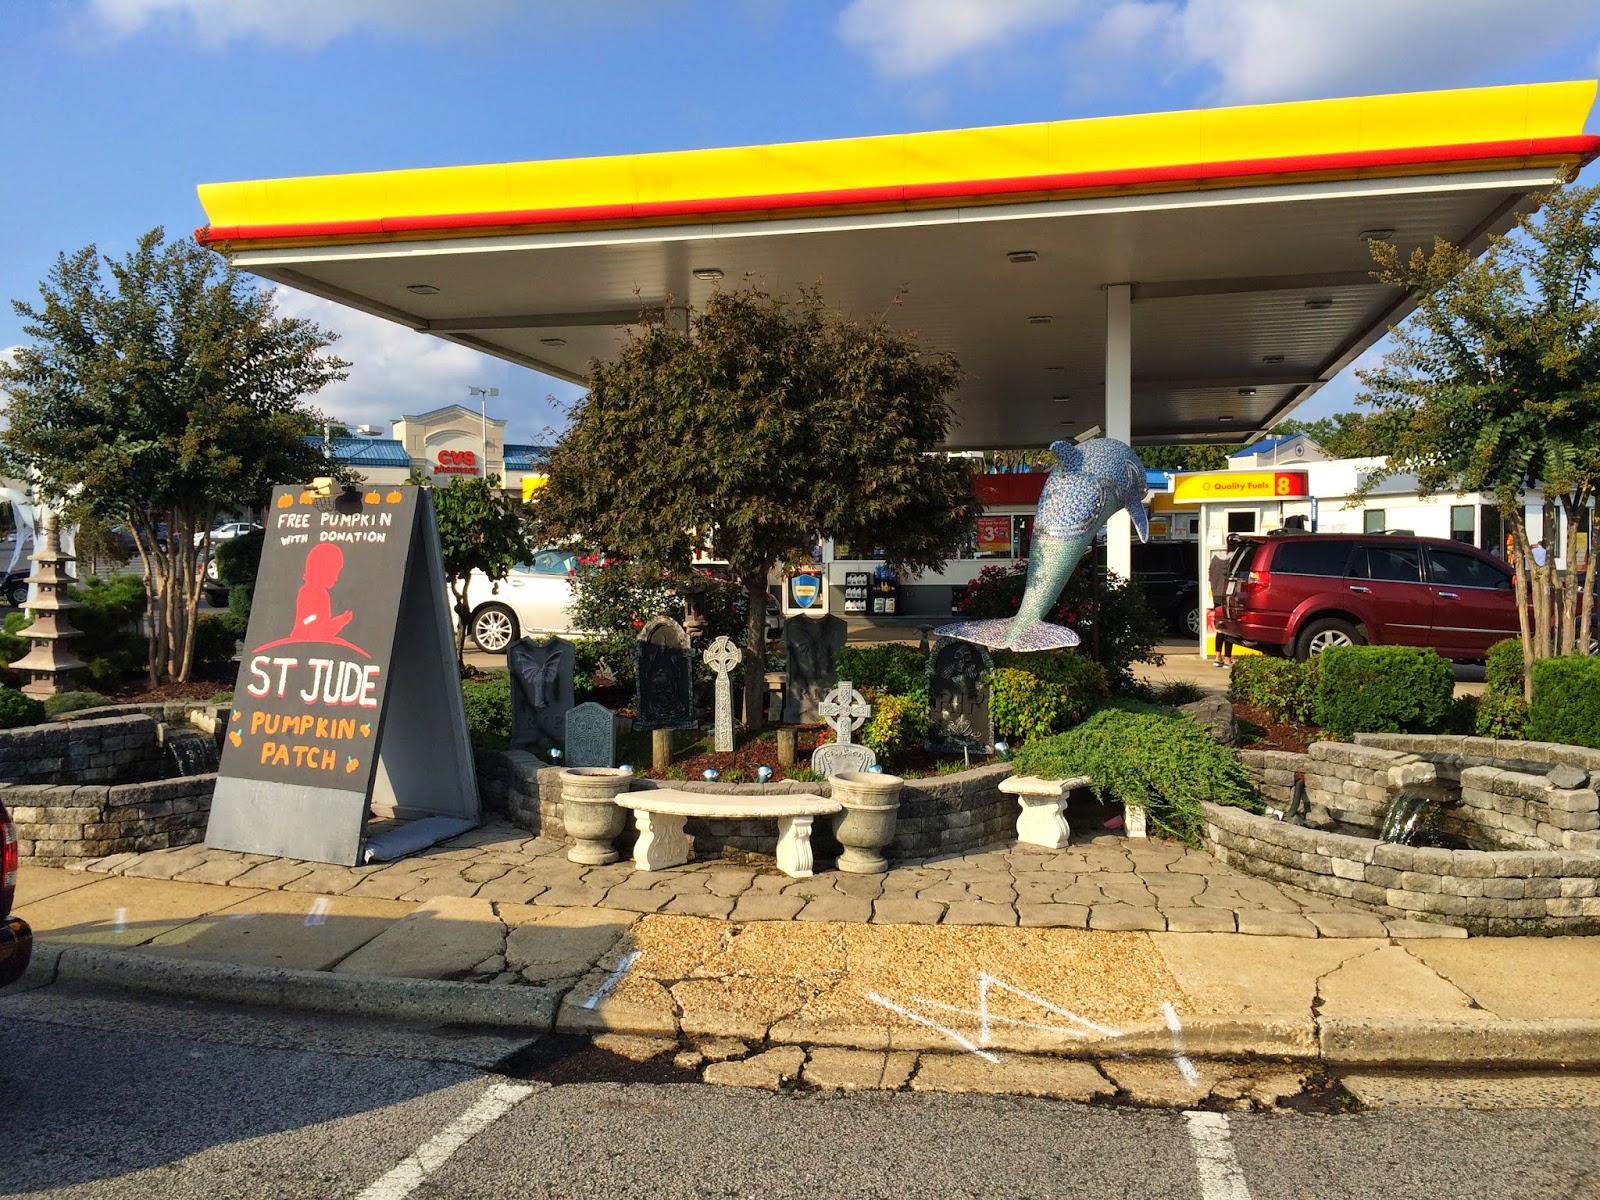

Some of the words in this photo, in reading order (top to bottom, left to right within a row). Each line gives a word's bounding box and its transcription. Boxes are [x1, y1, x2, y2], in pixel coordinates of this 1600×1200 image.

[437, 449, 476, 466] CVS
[433, 464, 479, 476] pharmacy
[1214, 481, 1246, 492] Quality
[1247, 481, 1270, 489] Fuels
[1276, 476, 1291, 495] 8
[277, 512, 312, 529] FREE
[320, 511, 393, 528] PUMPKIN
[280, 533, 309, 547] WITH
[319, 530, 387, 544] DONATION
[247, 655, 299, 699] ST
[300, 658, 381, 709] JUDE
[933, 689, 986, 715] RIP
[250, 710, 356, 740] PUMPKIN
[260, 741, 337, 771] PATCH
